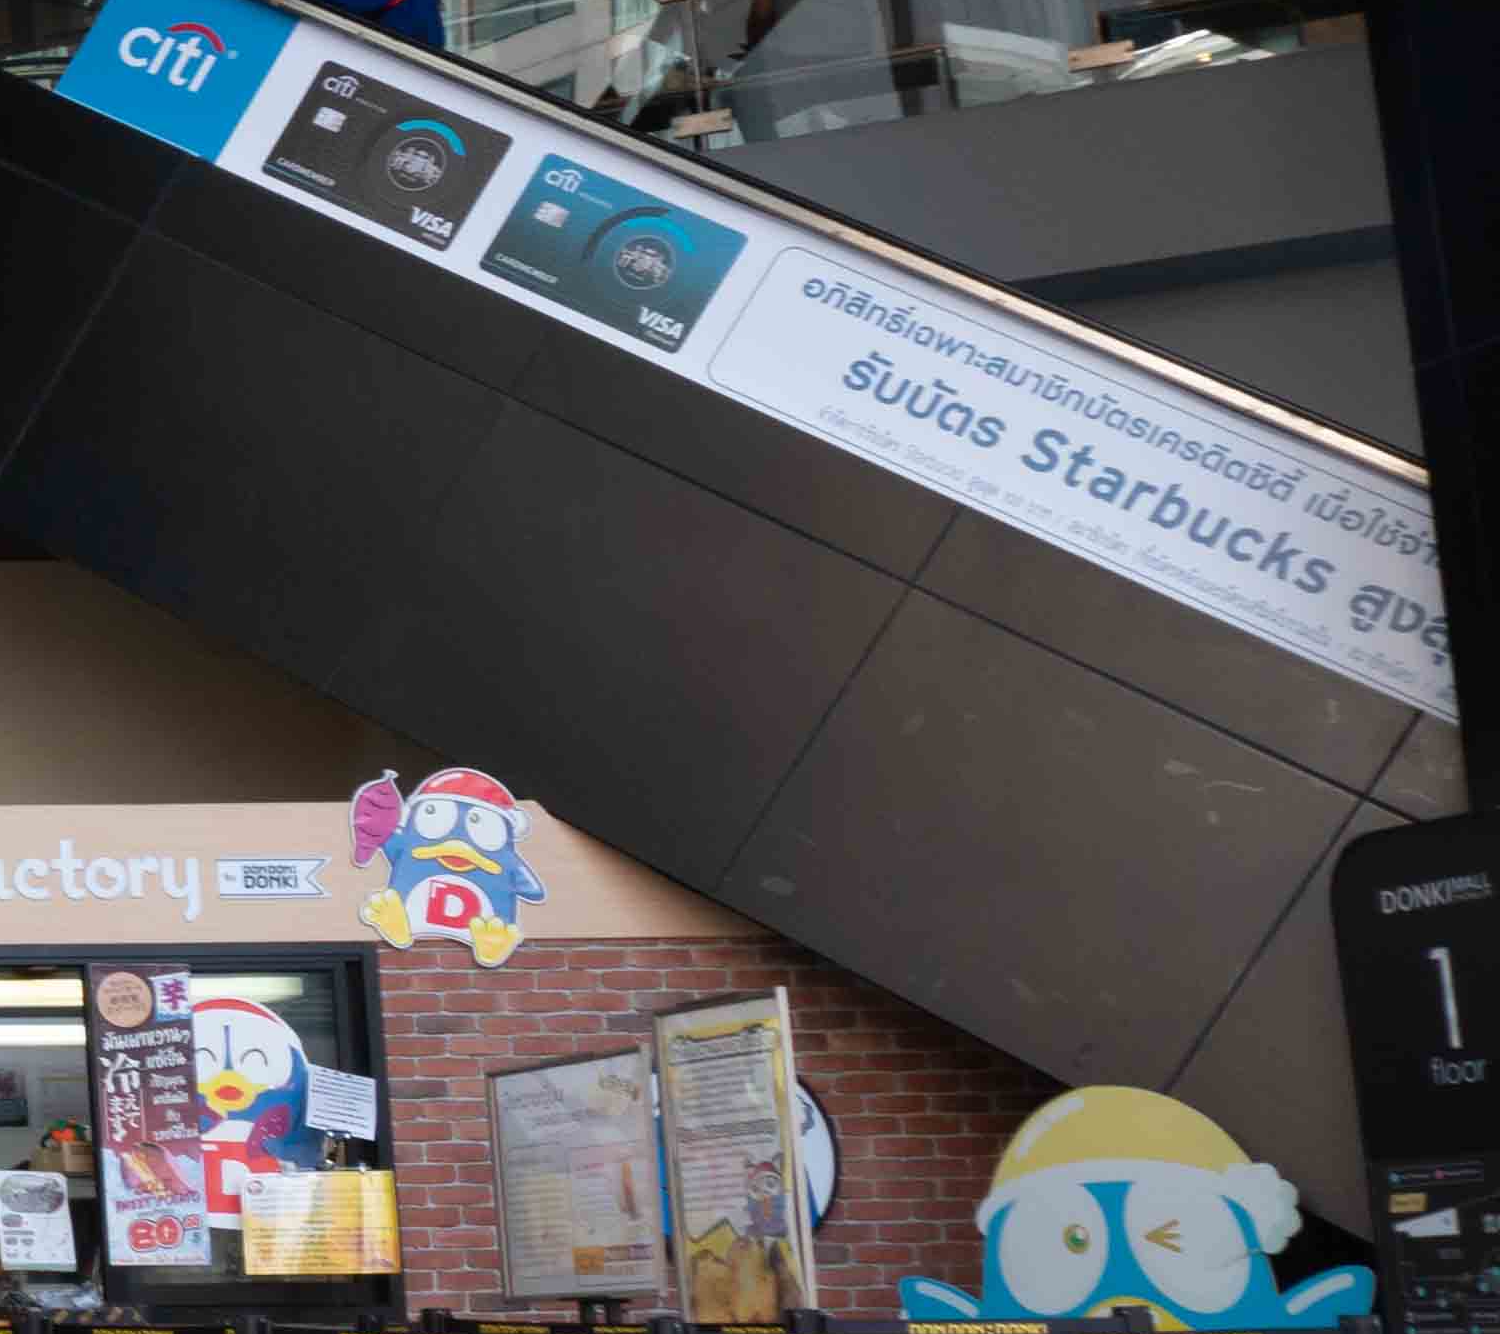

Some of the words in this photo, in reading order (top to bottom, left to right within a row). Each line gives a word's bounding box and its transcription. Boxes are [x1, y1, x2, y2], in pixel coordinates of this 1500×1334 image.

[118, 23, 225, 95] citi
[322, 74, 361, 100] citi
[543, 168, 584, 194] citi
[410, 204, 454, 238] VISA
[636, 305, 685, 340] VISA
[842, 350, 1007, 448] รับบัตร
[1020, 427, 1337, 594] Starbucks
[243, 874, 298, 889] DONKI
[1379, 877, 1453, 915] DONKI
[1428, 946, 1464, 1050] 1
[1430, 1056, 1486, 1085] floor
